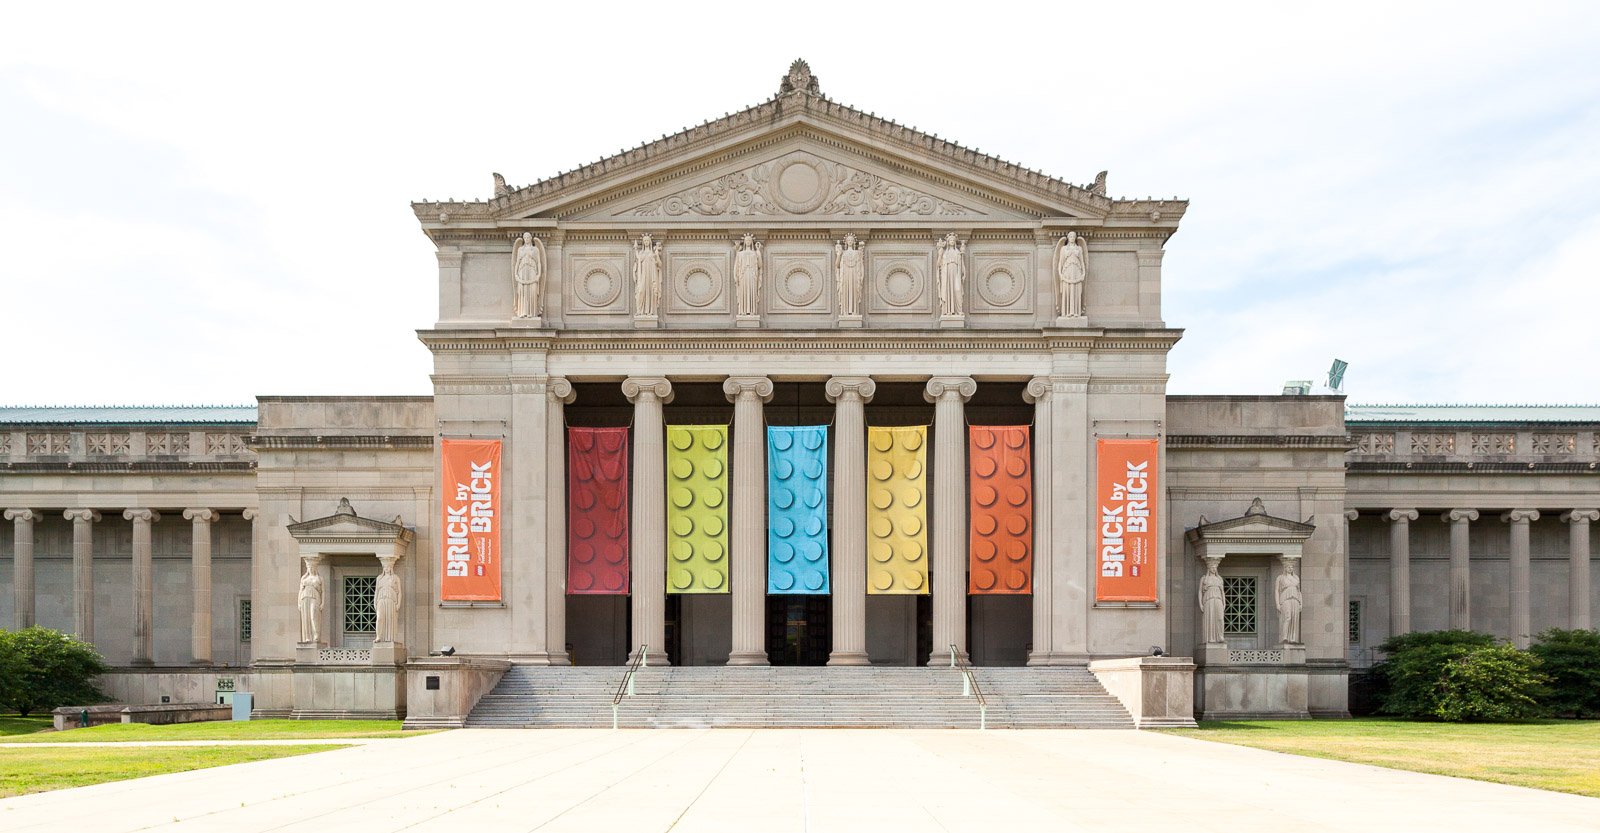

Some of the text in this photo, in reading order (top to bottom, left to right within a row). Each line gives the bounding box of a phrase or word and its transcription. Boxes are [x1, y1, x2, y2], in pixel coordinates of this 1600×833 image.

[447, 483, 470, 576] BRICK by
[471, 461, 493, 532] BRICK
[1102, 483, 1126, 577] BRICK by
[1127, 461, 1149, 532] BRICK
